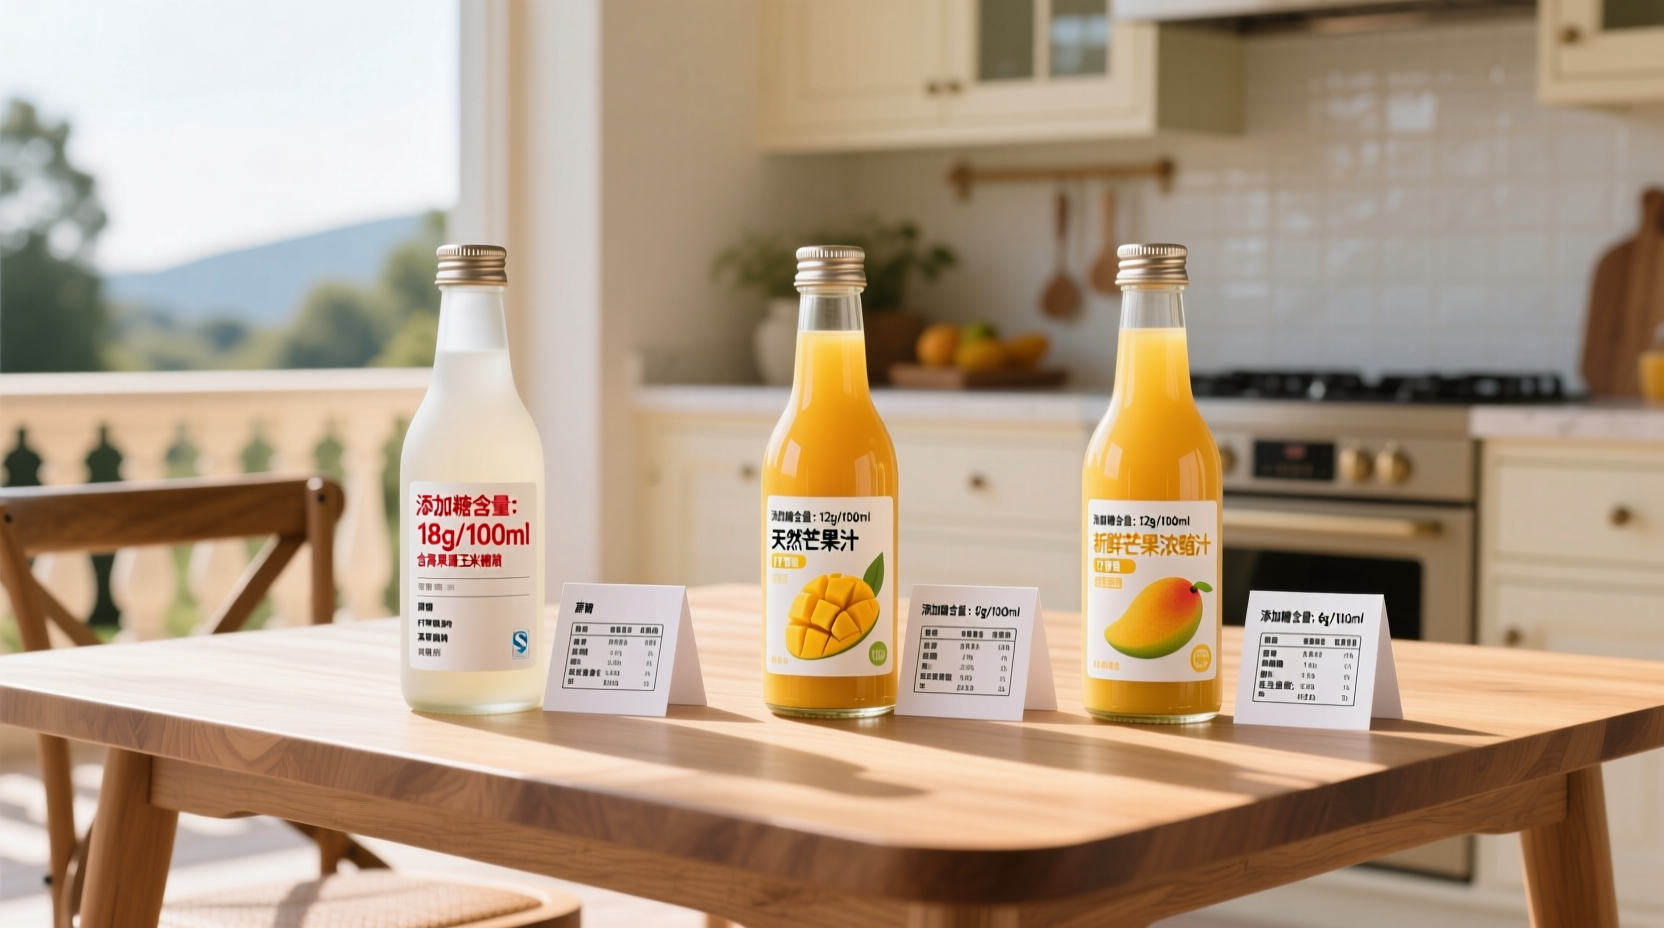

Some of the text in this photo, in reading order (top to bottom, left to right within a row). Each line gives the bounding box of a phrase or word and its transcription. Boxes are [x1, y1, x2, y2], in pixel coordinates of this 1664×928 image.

[416, 494, 518, 517] 添加糖含量:
[417, 521, 530, 552] 18g/100ml
[771, 528, 860, 552] 天然芒果汁
